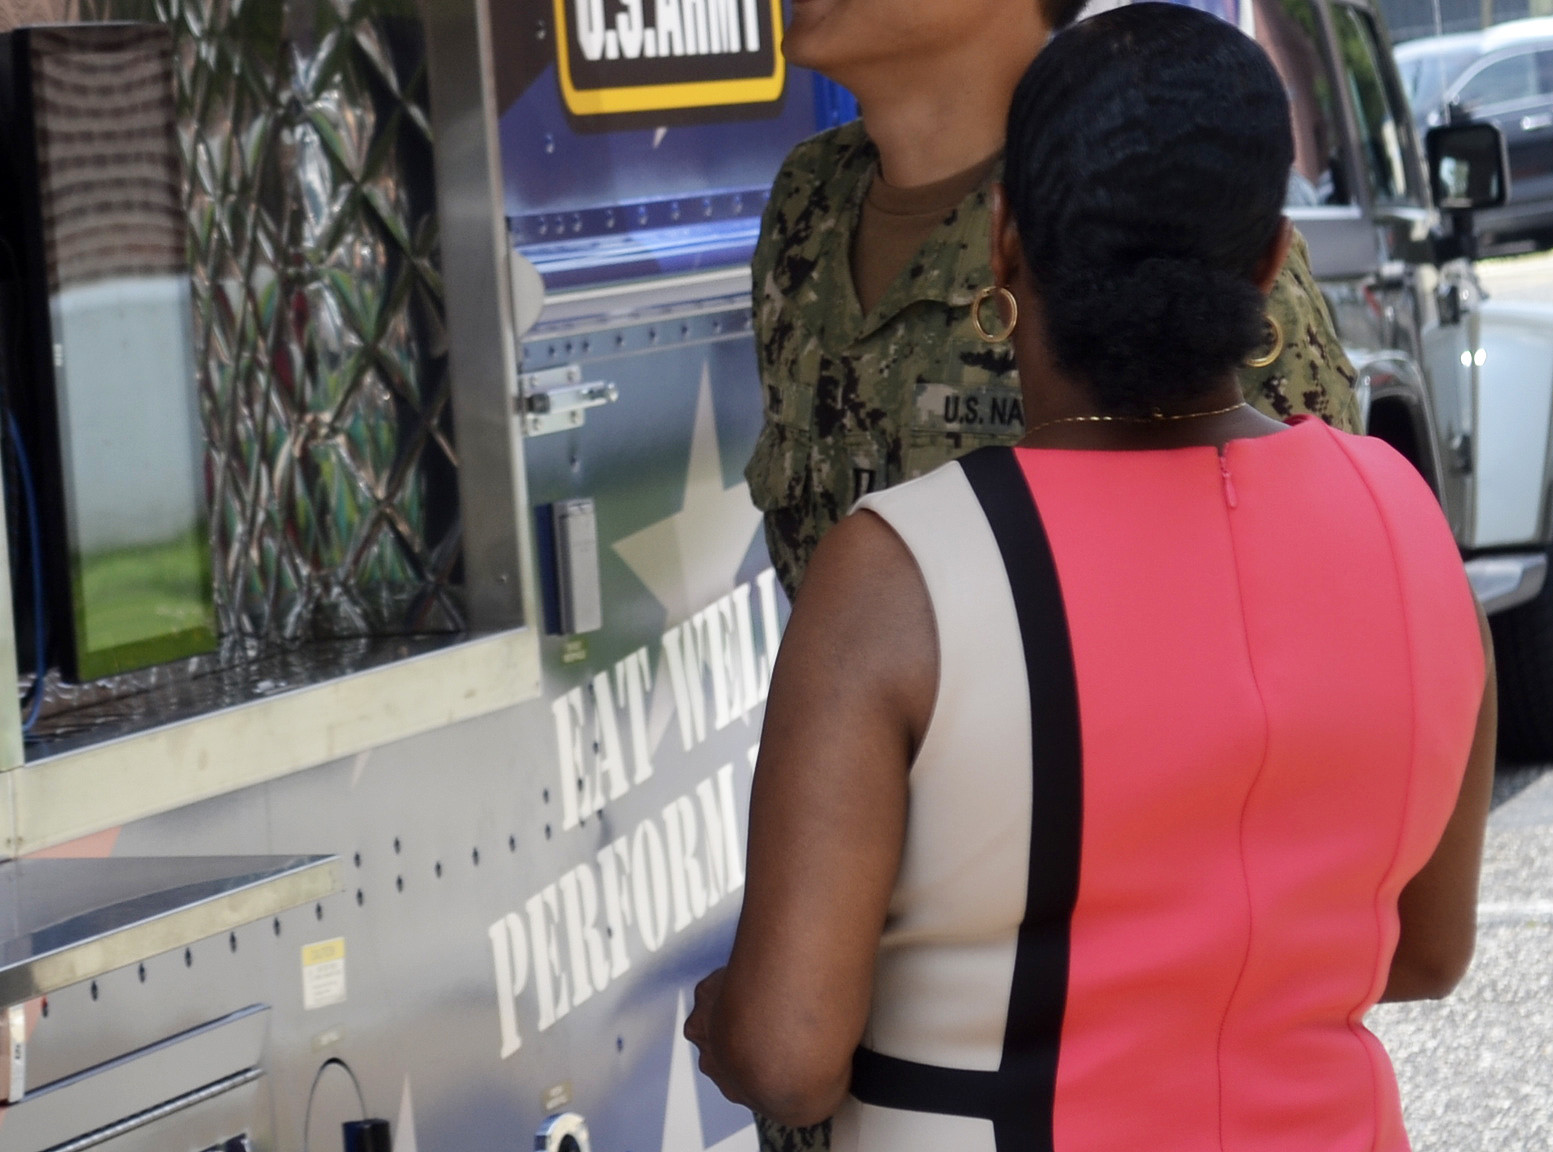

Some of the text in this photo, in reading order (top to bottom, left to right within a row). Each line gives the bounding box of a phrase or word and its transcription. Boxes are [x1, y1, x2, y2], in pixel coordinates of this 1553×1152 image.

[944, 395, 984, 425] U.S.
[552, 645, 654, 832] EAT
[488, 762, 745, 1060] PERFORM
